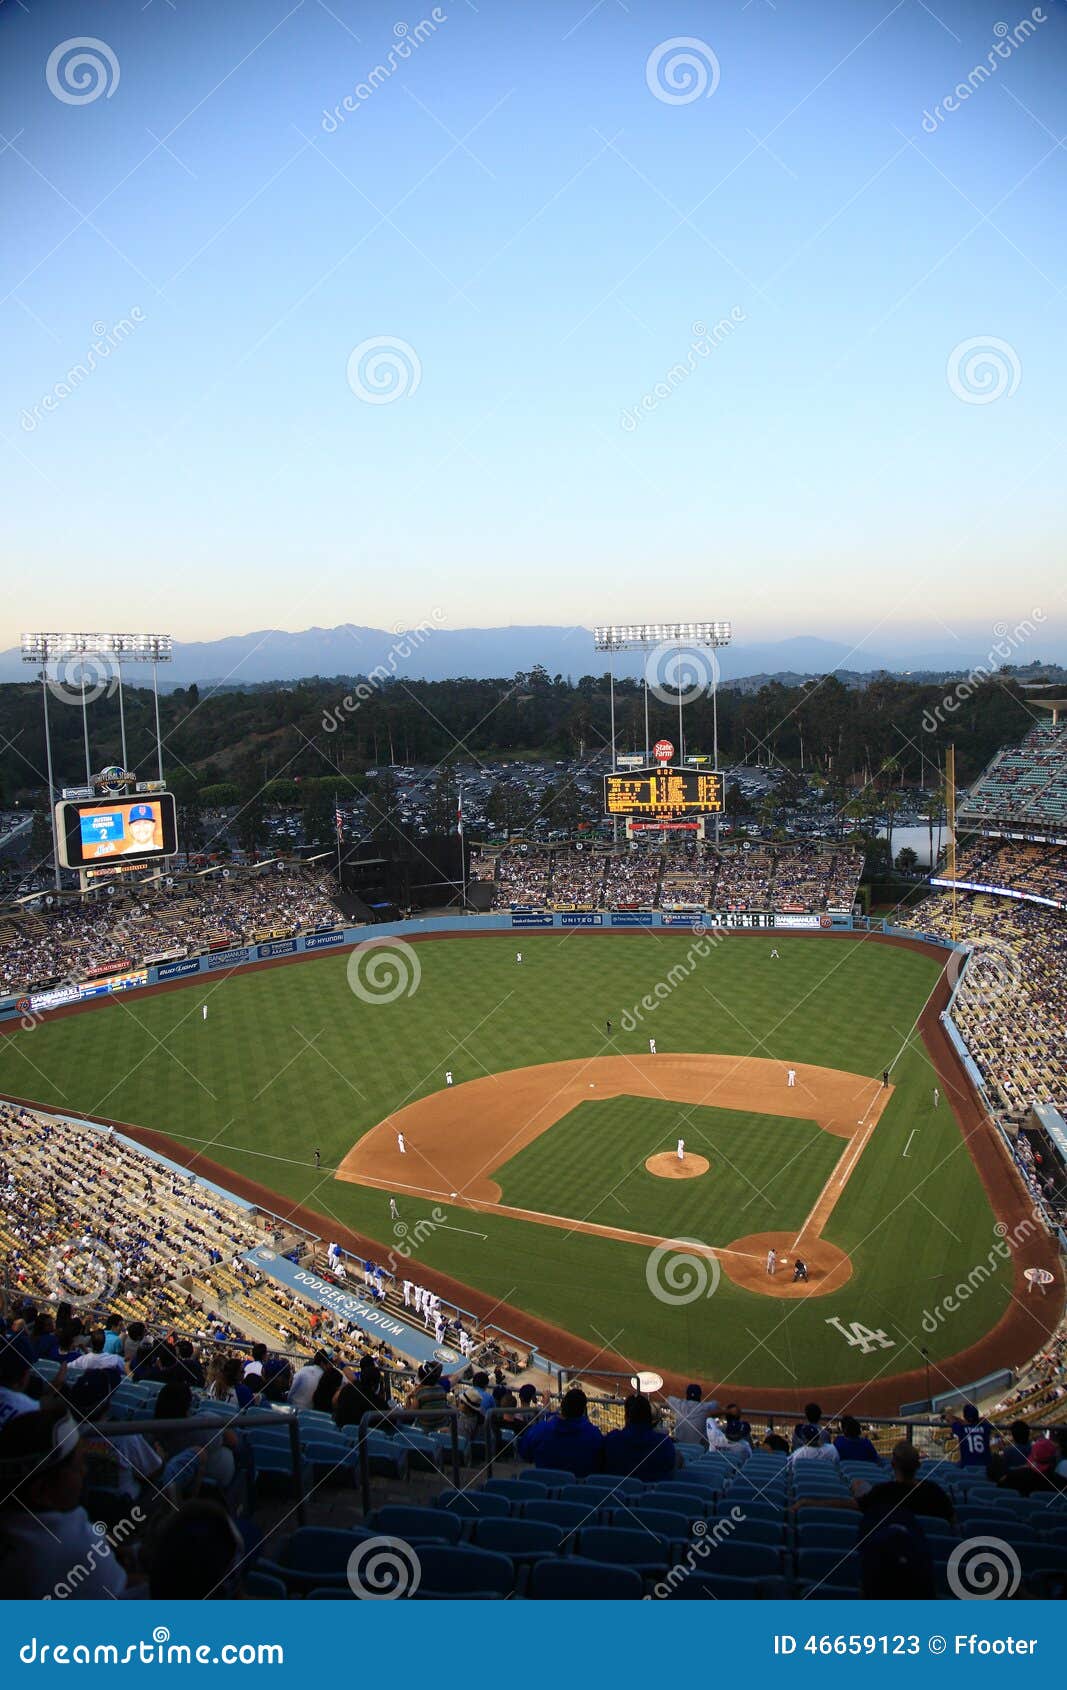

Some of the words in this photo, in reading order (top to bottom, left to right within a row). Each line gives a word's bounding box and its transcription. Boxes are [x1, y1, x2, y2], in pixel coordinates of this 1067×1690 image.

[100, 828, 108, 839] 2
[317, 934, 344, 944] HYUNDAI
[293, 1272, 345, 1303] DODGER
[346, 1299, 405, 1336] STADIUM
[825, 1316, 896, 1354] LA
[967, 1434, 985, 1454] 16
